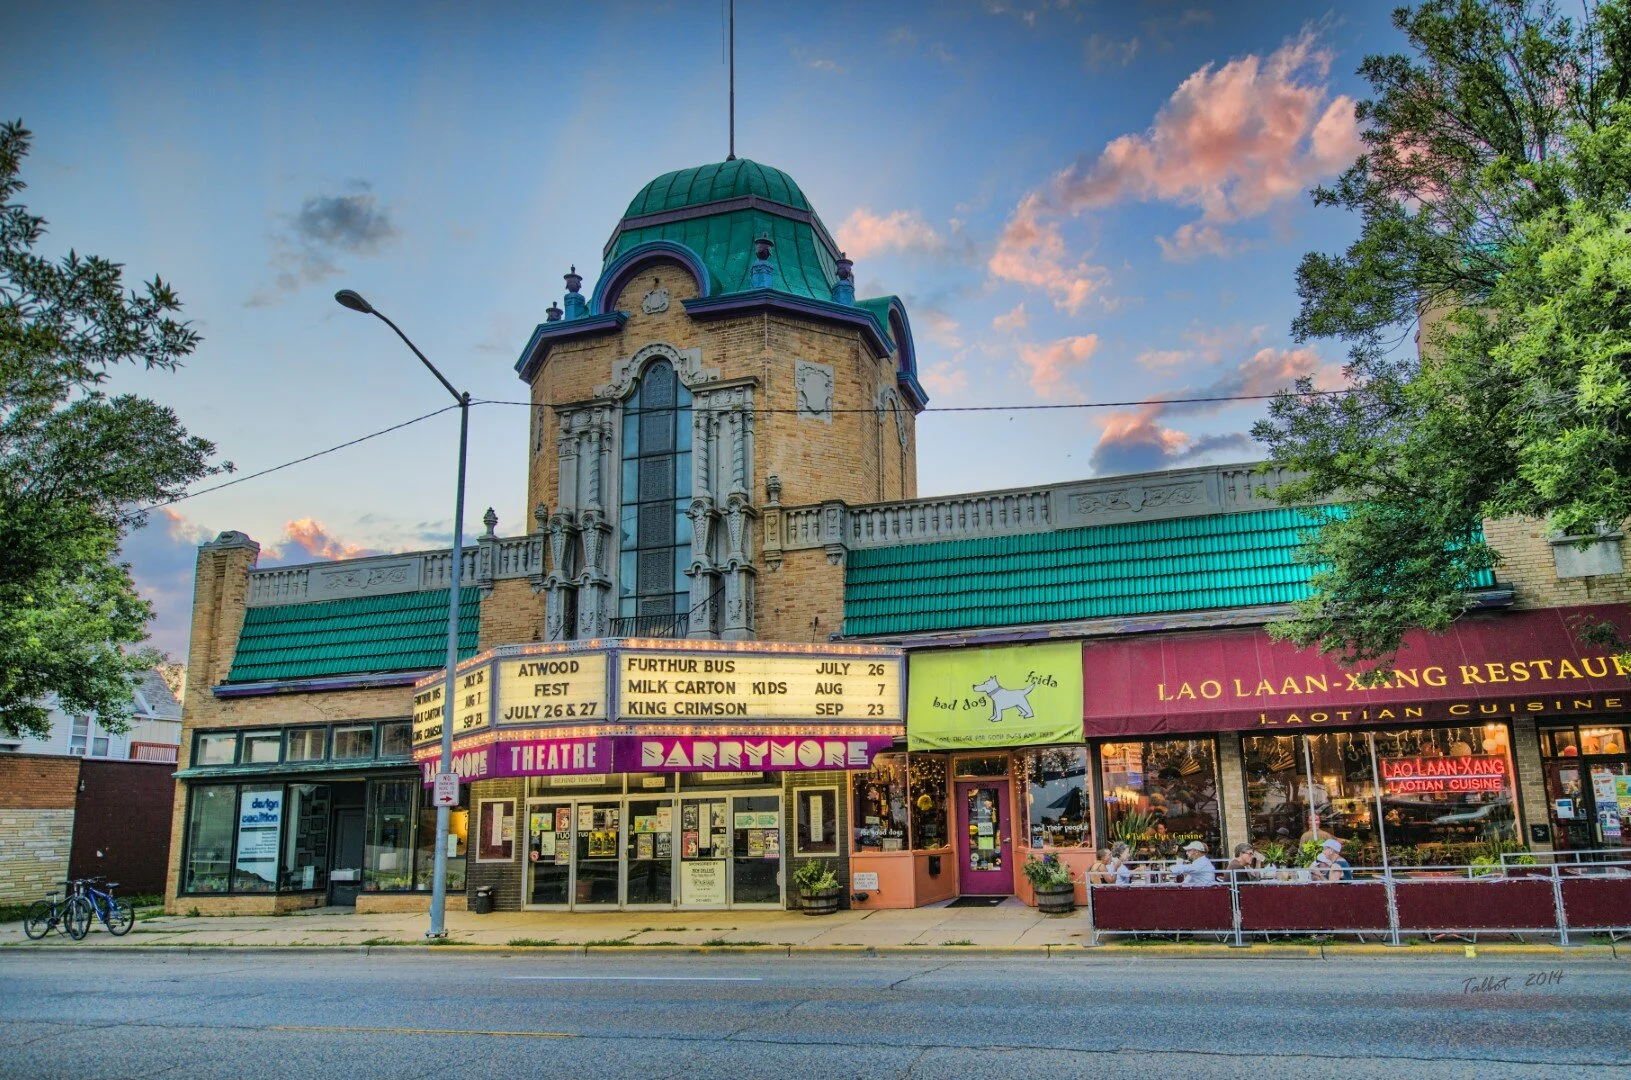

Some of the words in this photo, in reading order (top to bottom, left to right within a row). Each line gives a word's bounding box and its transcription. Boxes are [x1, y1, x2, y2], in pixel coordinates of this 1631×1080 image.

[518, 660, 579, 678] ATWOOD
[628, 658, 697, 673] FURTHUR
[704, 660, 735, 673] BUS
[816, 662, 850, 676] JULY
[868, 664, 885, 676] 26
[628, 679, 668, 694] MILK
[674, 681, 736, 694] CARTON
[753, 681, 788, 695] KIDS
[815, 682, 843, 696] AUG
[878, 683, 885, 696] 7
[1025, 671, 1058, 688] frida
[535, 682, 569, 697] FEST
[1157, 680, 1222, 701] LAO
[504, 704, 541, 720] JULY
[544, 703, 565, 718] 26
[566, 703, 576, 717] &
[580, 702, 598, 717] 27
[628, 701, 667, 715] KING
[674, 702, 747, 716] CRIMSON
[816, 703, 844, 716] SEP
[868, 703, 884, 716] 23
[933, 696, 957, 710] bad
[963, 696, 987, 710] dog
[1261, 707, 1423, 725] LAOTIAN
[1449, 698, 1622, 716] CUISINE
[511, 743, 596, 771] THEATRE
[641, 740, 868, 769] BARRYMORE
[1382, 758, 1413, 778] LAO
[1416, 755, 1505, 776] LAAN-XANG
[1390, 779, 1444, 792] LAOTIAN
[1450, 779, 1502, 791] CUISINE
[888, 828, 903, 837] dogs
[1064, 823, 1089, 833] people
[1172, 830, 1204, 840] Cuisine
